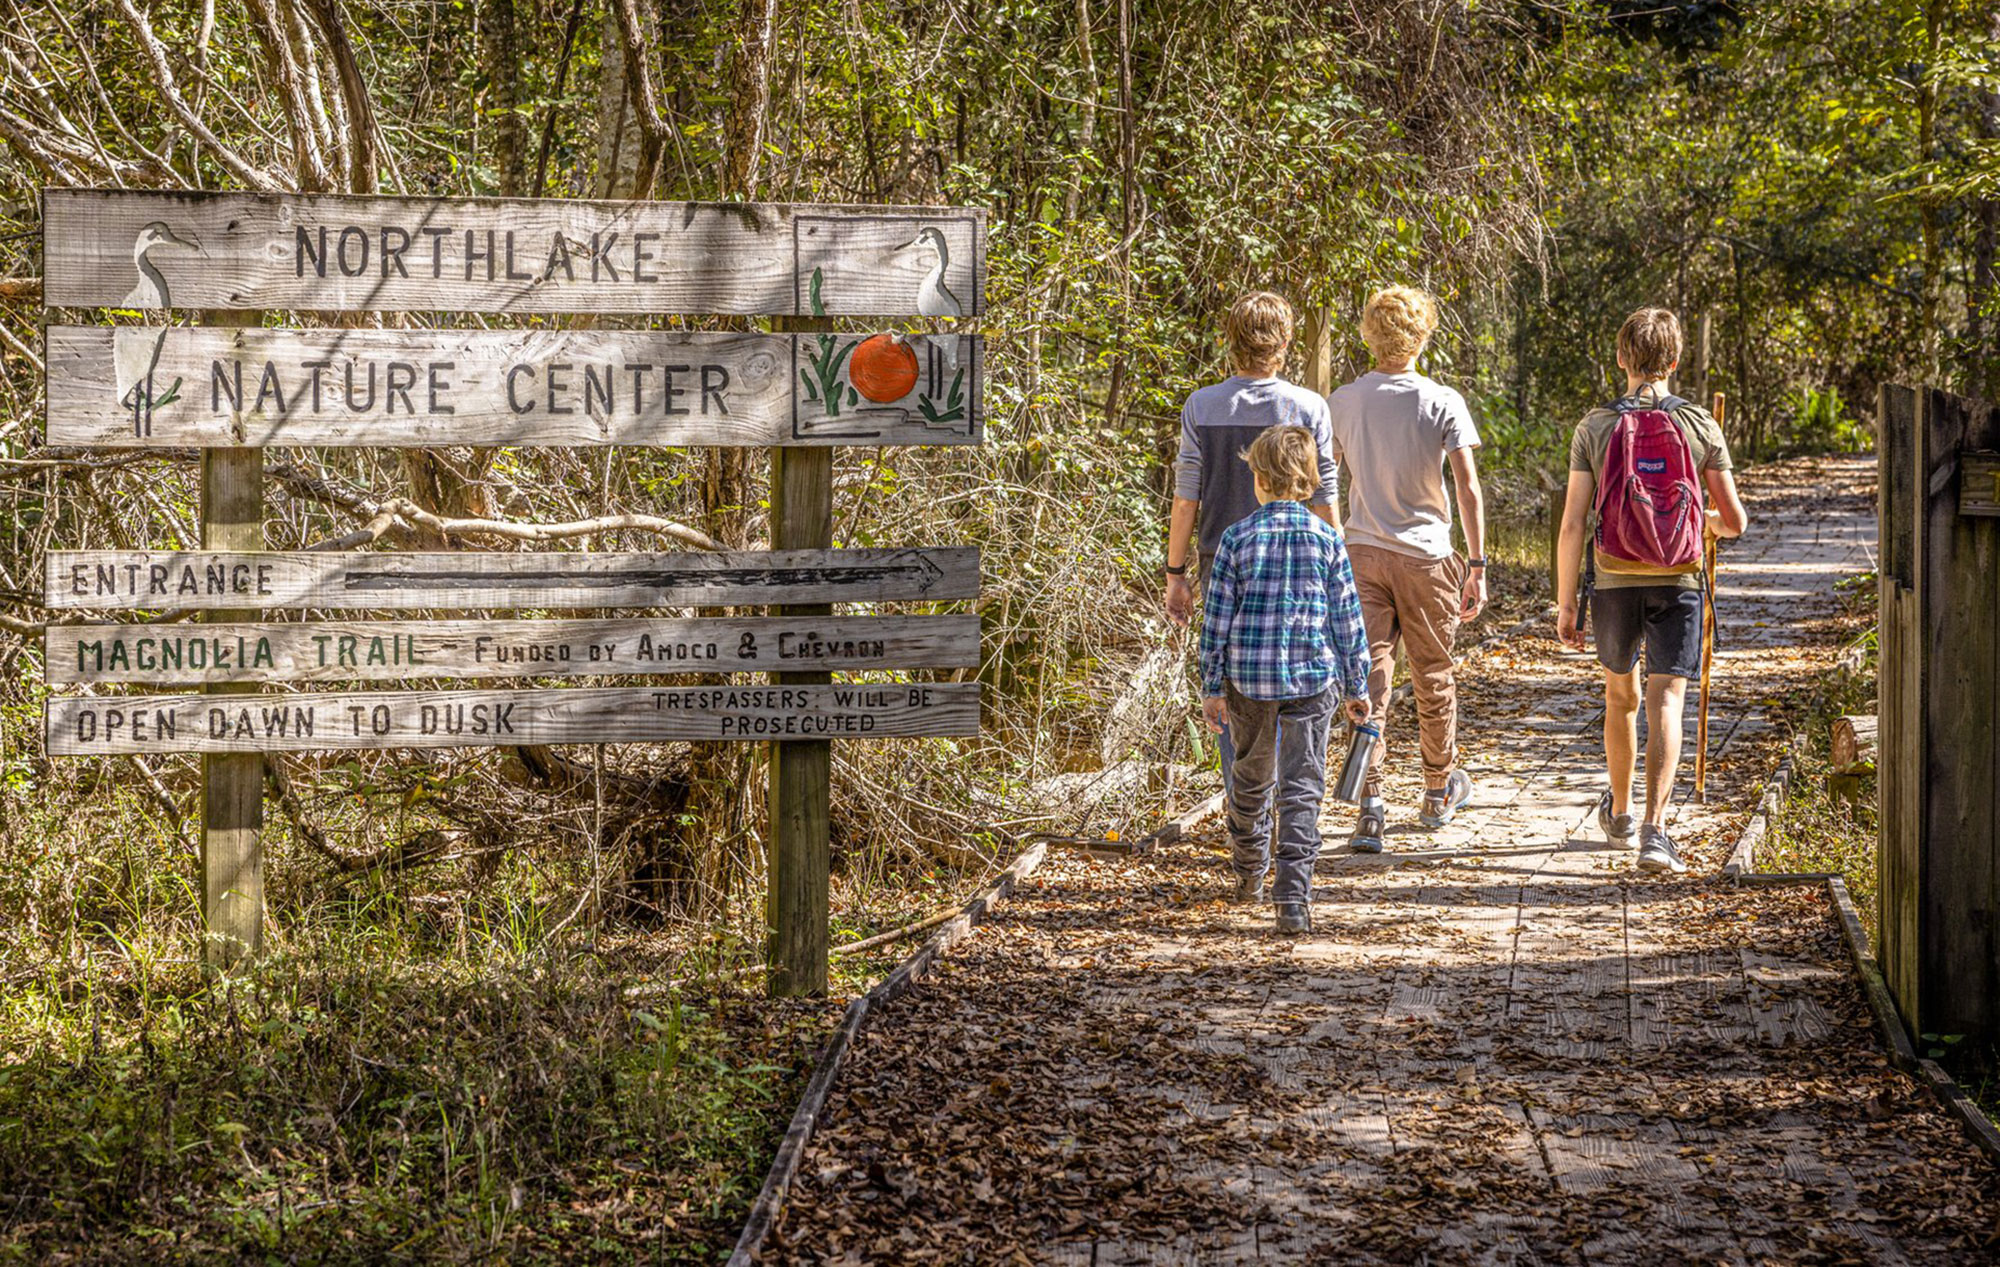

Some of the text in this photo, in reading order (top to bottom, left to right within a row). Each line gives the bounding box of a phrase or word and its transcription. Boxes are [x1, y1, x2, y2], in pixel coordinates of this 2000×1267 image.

[296, 224, 661, 284] NORTHLAKE
[211, 360, 730, 415] NATURE CENTER
[71, 564, 274, 596] ENTRANCE
[77, 637, 275, 672] MAGNOLIA
[312, 634, 424, 667] TRAIL
[737, 632, 758, 659] &
[834, 690, 889, 708] WILL
[908, 688, 934, 707] BE
[78, 702, 516, 743] OPEN DAWN TO DUSK
[721, 714, 875, 736] PROSECUTED
